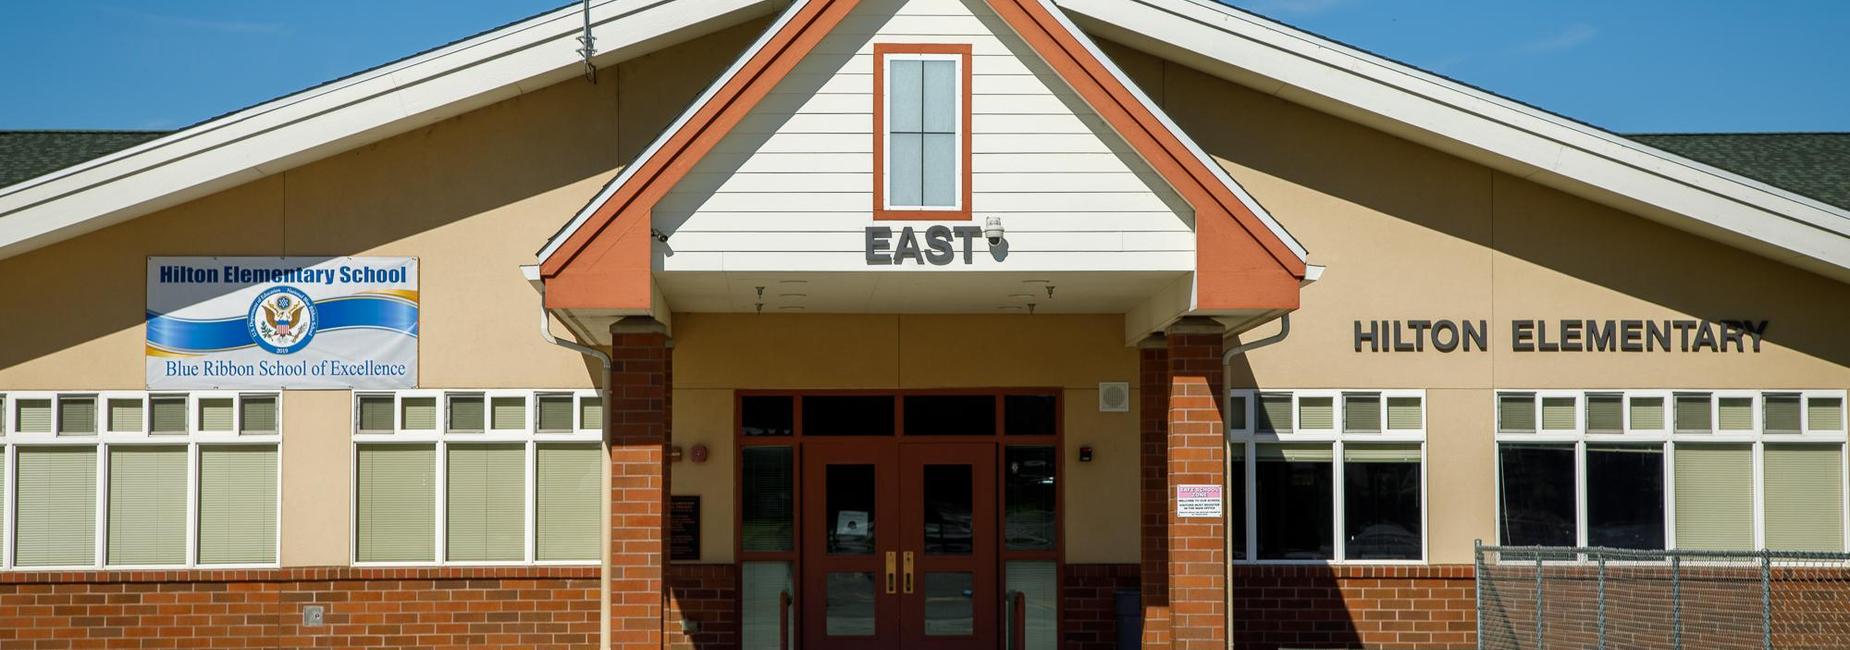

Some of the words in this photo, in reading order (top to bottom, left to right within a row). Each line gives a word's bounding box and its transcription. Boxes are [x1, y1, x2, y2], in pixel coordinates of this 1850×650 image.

[865, 225, 982, 265] EAST
[160, 266, 218, 283] Hilton
[224, 266, 334, 285] Elementary
[340, 266, 406, 283] School
[1354, 319, 1488, 353] HILTON
[1512, 319, 1768, 353] ELEMENTARY
[166, 360, 198, 376] Blue
[204, 360, 254, 376] Ribbon
[260, 360, 307, 376] School
[312, 360, 327, 376] of
[331, 360, 406, 376] Excellence
